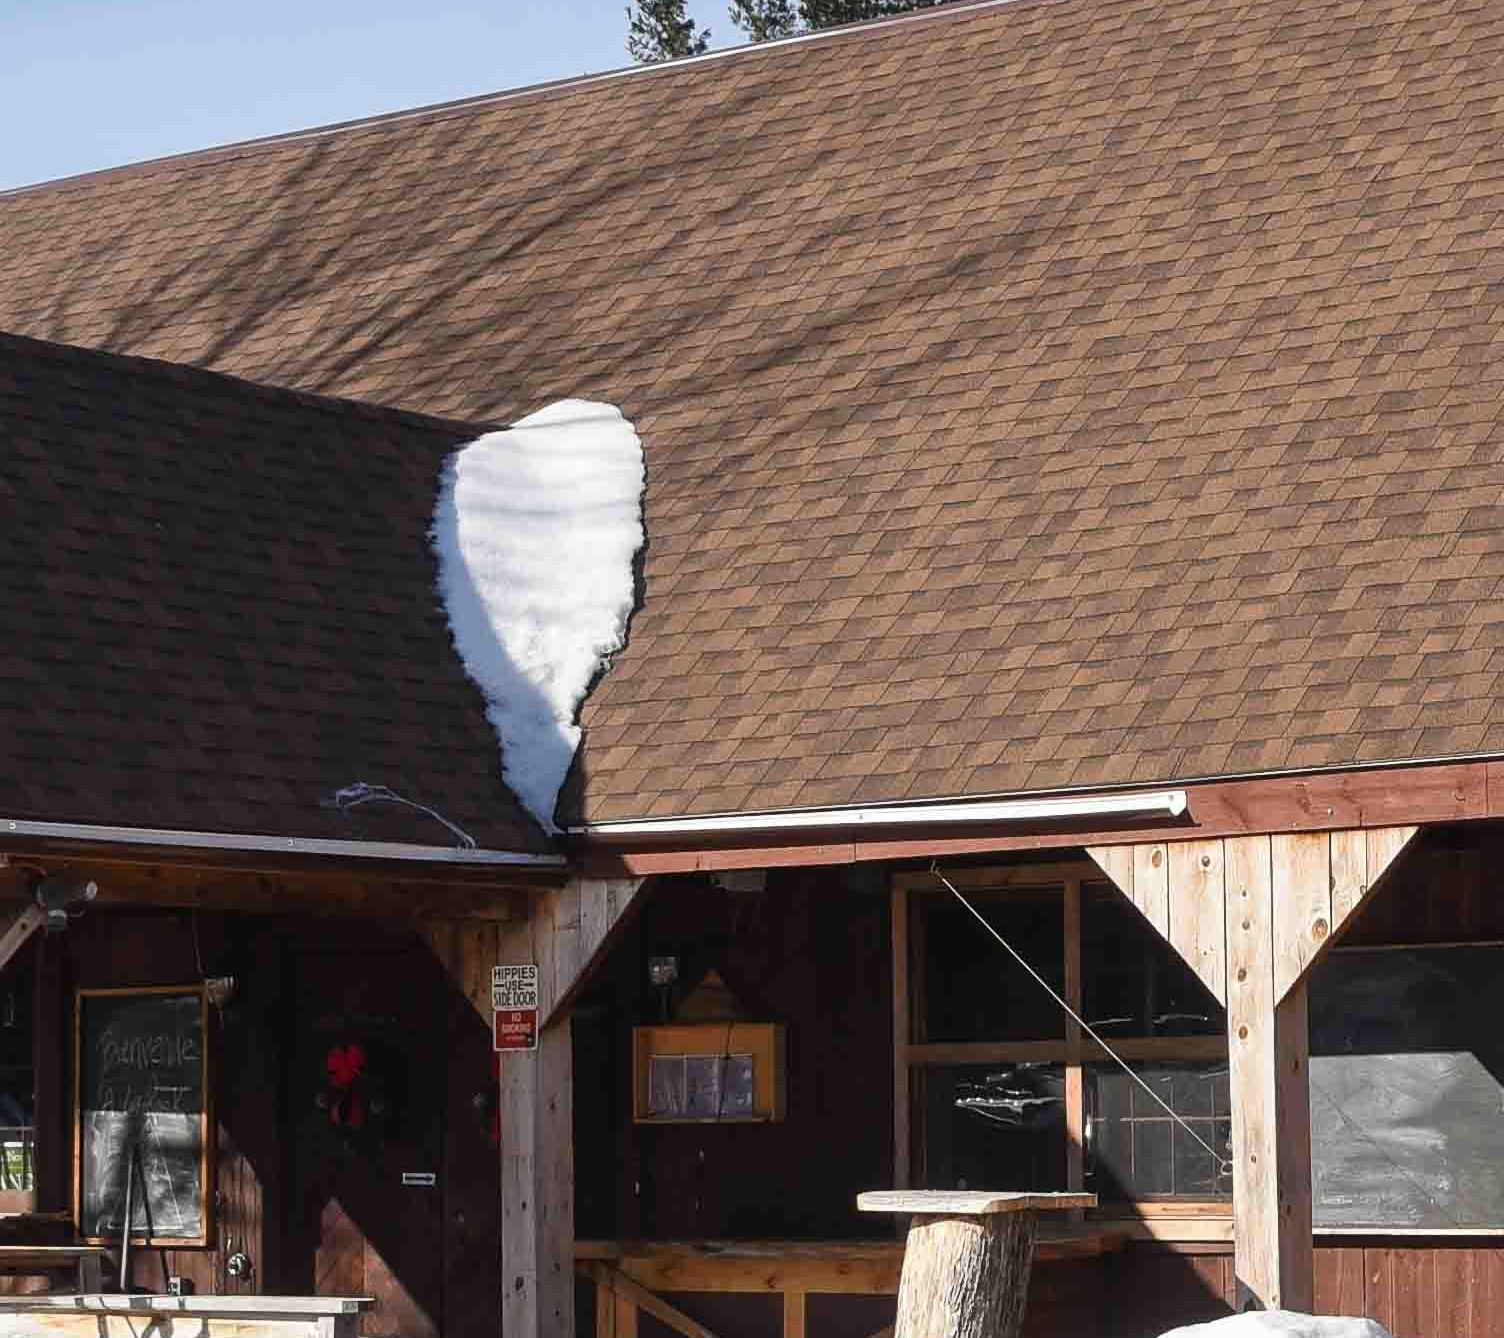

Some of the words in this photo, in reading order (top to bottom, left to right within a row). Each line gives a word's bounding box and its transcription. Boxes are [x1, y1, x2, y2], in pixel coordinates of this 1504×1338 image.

[494, 966, 536, 980] HIPPIES
[505, 980, 524, 991] USE
[494, 991, 512, 1006] SIDE
[514, 991, 536, 1006] DOOR
